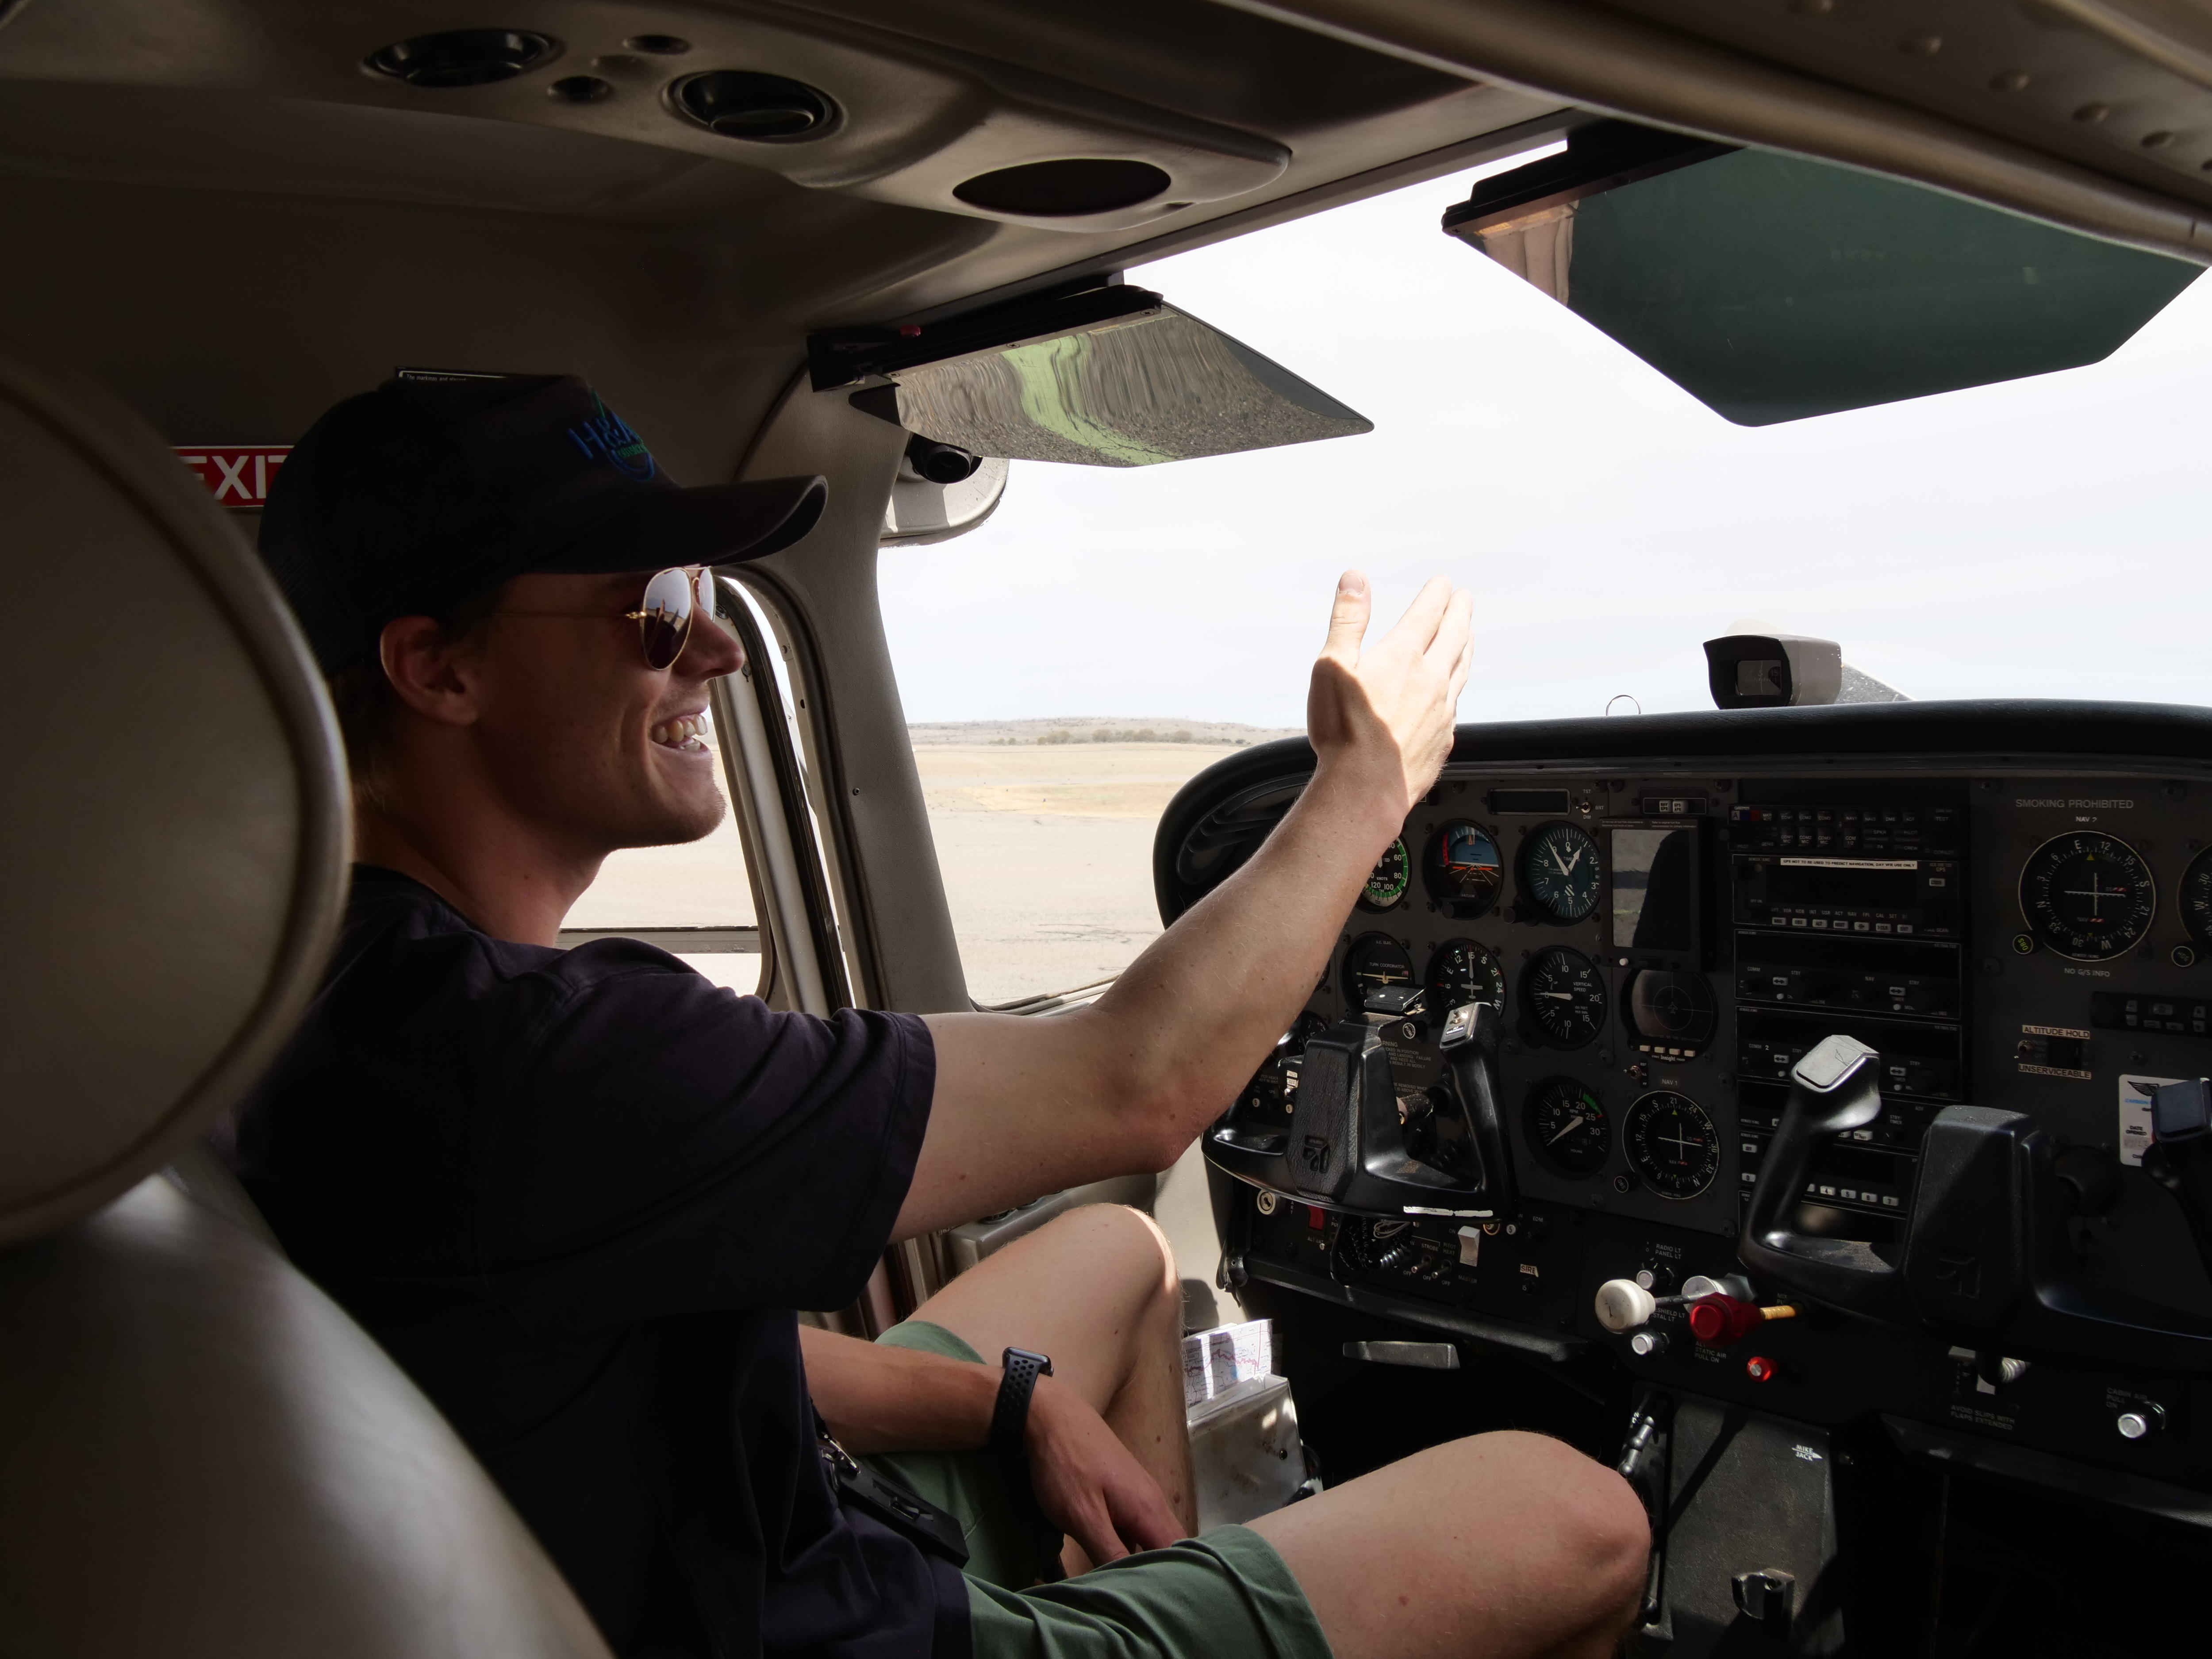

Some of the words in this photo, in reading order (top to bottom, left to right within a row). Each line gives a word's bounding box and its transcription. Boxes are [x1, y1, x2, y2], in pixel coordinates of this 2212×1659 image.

[2015, 799, 2065, 808] SMOKING
[2068, 799, 2134, 809] PROHIBITED
[2016, 937, 2029, 952] OBS
[1454, 955, 1463, 964] 12
[1447, 967, 1454, 975] E
[1496, 982, 1504, 994] 24
[2024, 1026, 2063, 1036] ALTITUDE
[2019, 1064, 2091, 1079] UNSERVICEABLE
[1562, 1099, 1570, 1108] 15
[1575, 1101, 1586, 1110] 20
[1553, 1107, 1561, 1116] 10
[1688, 1104, 1697, 1114] 24
[1585, 1112, 1596, 1121] 25
[1639, 1113, 1647, 1121] 15
[1704, 1121, 1713, 1130] W
[1590, 1127, 1600, 1136] 30
[1421, 1243, 1439, 1252] STROBE
[1655, 1243, 1674, 1252] RADIO
[1655, 1249, 1673, 1258] PANEL
[1458, 1275, 1477, 1284] MASTER
[1695, 1346, 1716, 1356] STATIC
[1694, 1352, 1710, 1361] PULL
[2107, 1387, 2131, 1398] CABIN
[1951, 1405, 1973, 1414] AVOID
[1974, 1410, 1995, 1420] SLIPS
[1997, 1415, 2015, 1424] WITH
[1950, 1411, 1973, 1421] FLAPS
[1975, 1417, 2013, 1431] EXTENDED
[1796, 1444, 1813, 1455] MIKE
[1795, 1451, 1813, 1461] JACK
